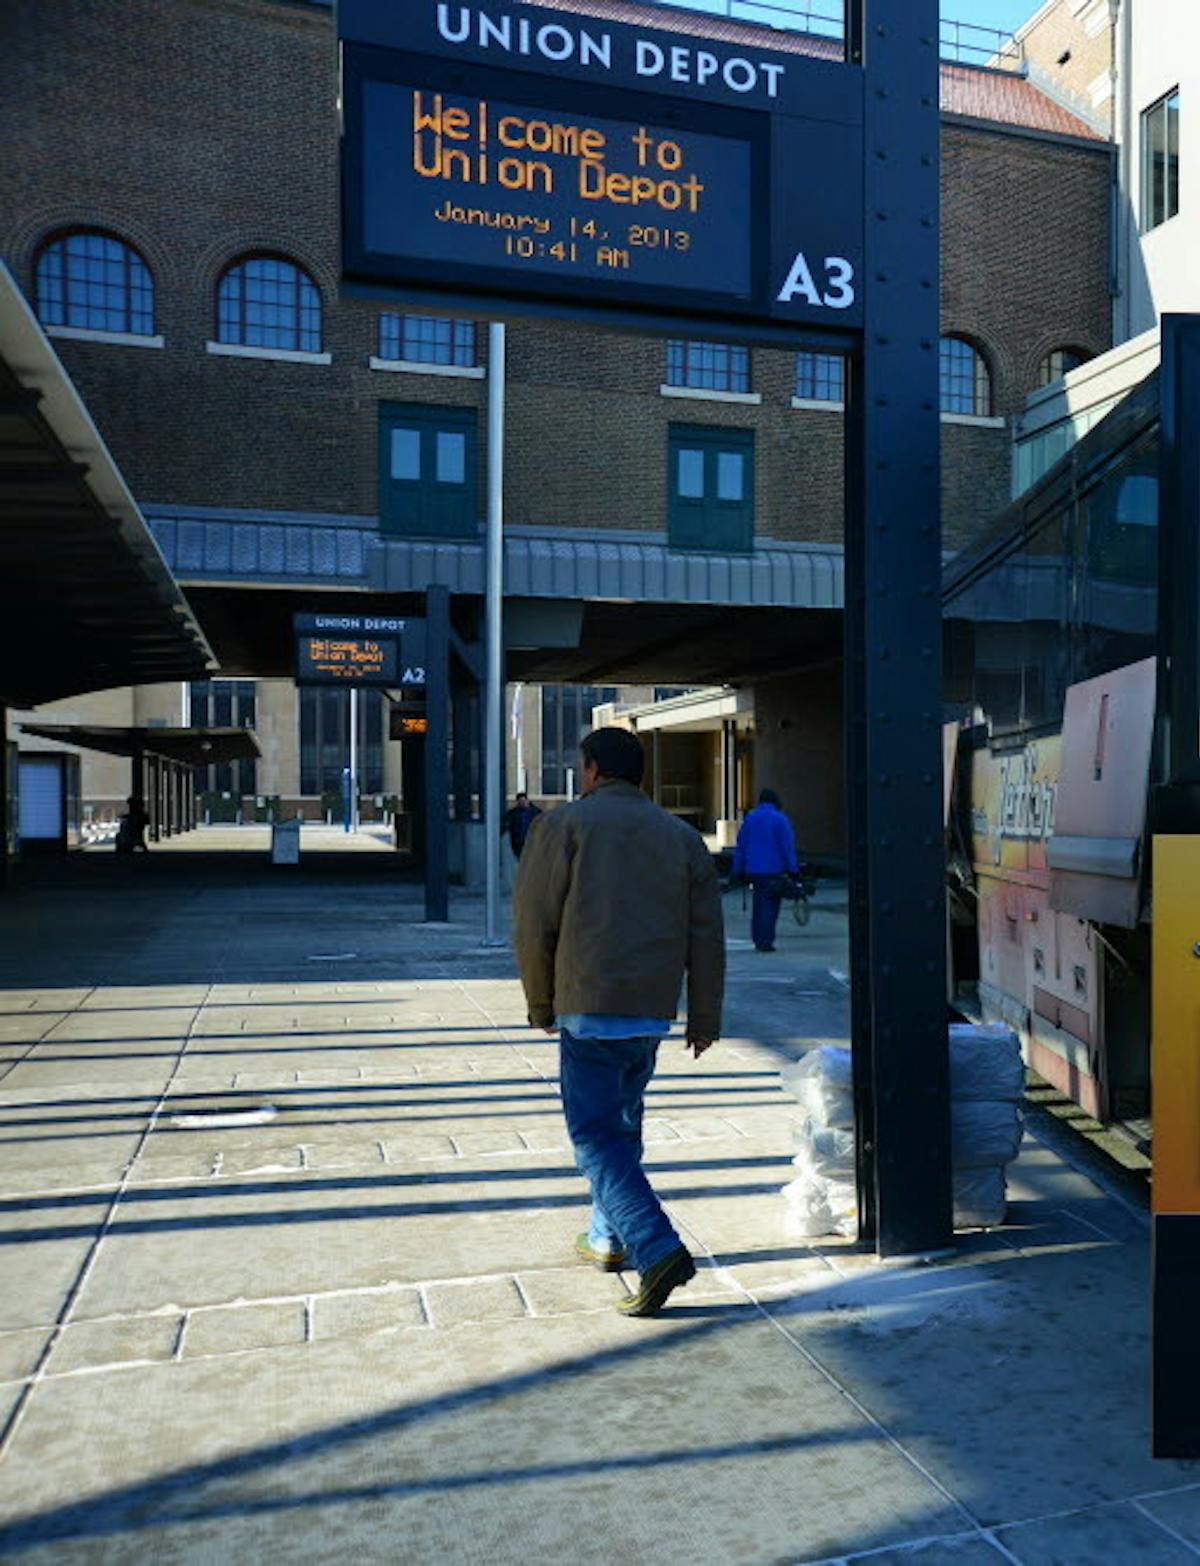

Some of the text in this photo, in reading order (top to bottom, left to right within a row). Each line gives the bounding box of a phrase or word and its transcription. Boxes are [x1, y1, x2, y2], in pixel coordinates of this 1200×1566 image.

[437, 4, 786, 97] UNION DEPOT
[413, 90, 683, 171] Welcome to
[413, 131, 704, 212] Union Depot
[435, 200, 691, 251] January 14, 2013
[505, 236, 629, 269] 10:41 AM
[777, 251, 855, 309] A3
[315, 618, 405, 630] UNION DEPOT
[401, 667, 425, 684] A2
